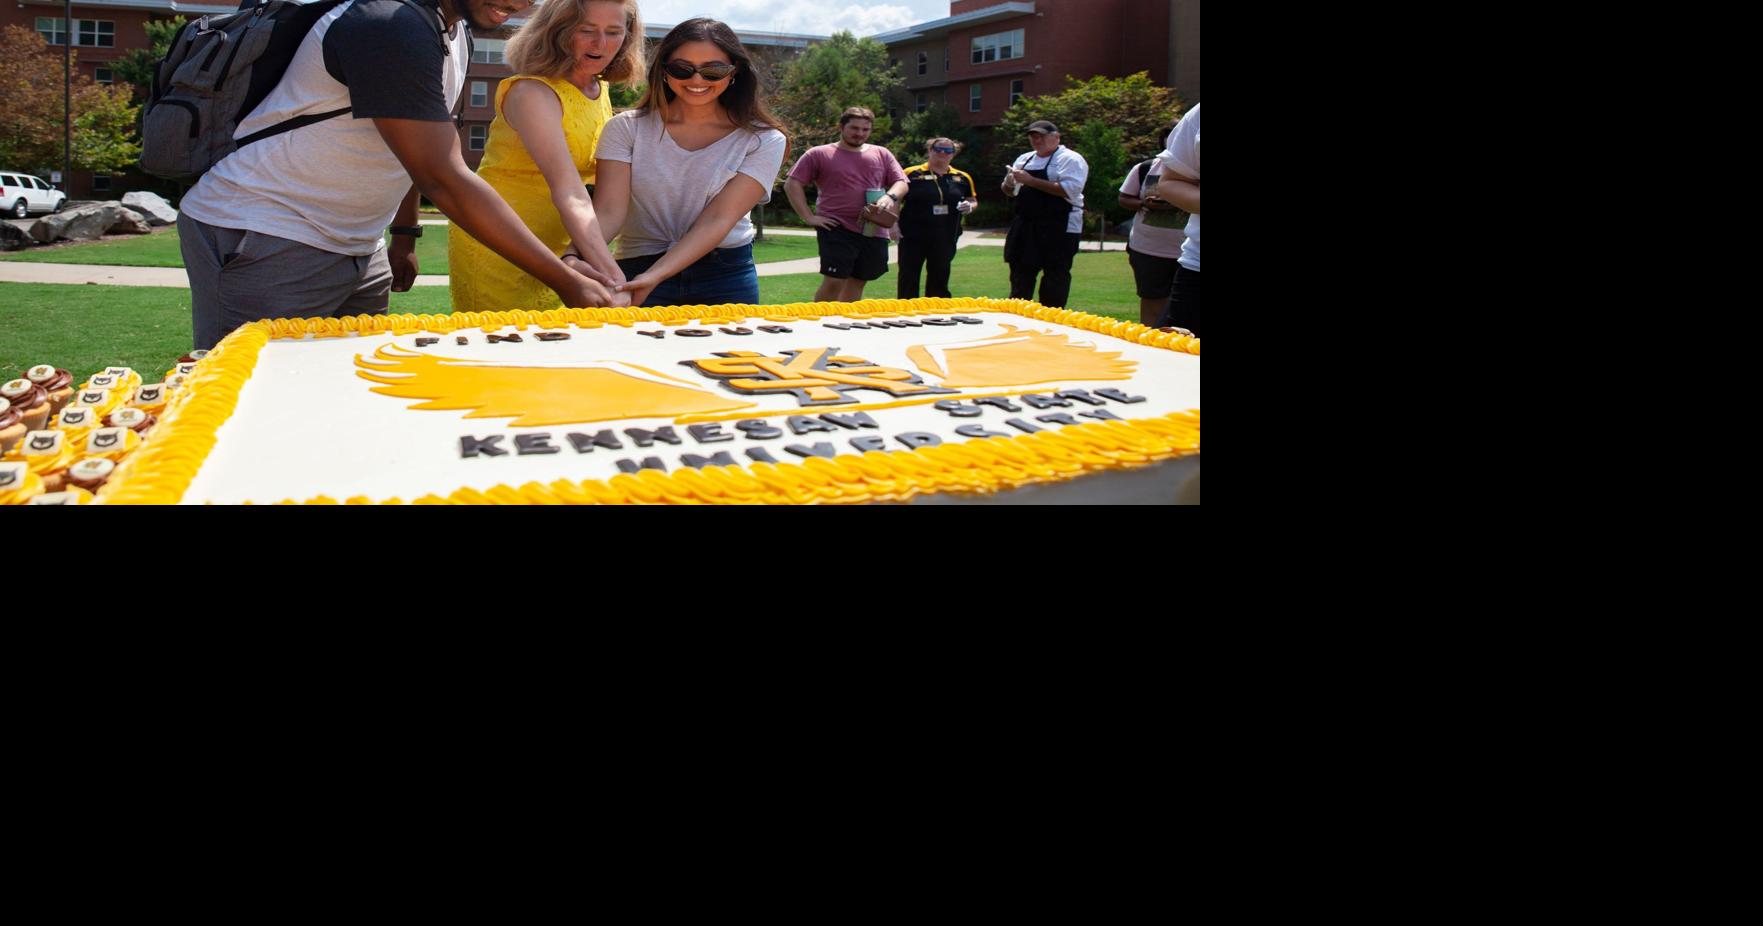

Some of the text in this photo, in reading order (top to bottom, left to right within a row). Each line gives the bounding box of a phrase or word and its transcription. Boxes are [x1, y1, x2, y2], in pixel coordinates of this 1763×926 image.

[414, 331, 572, 347] FIND
[636, 324, 794, 339] YOUR
[460, 388, 1147, 459] KENNESAW STATE
